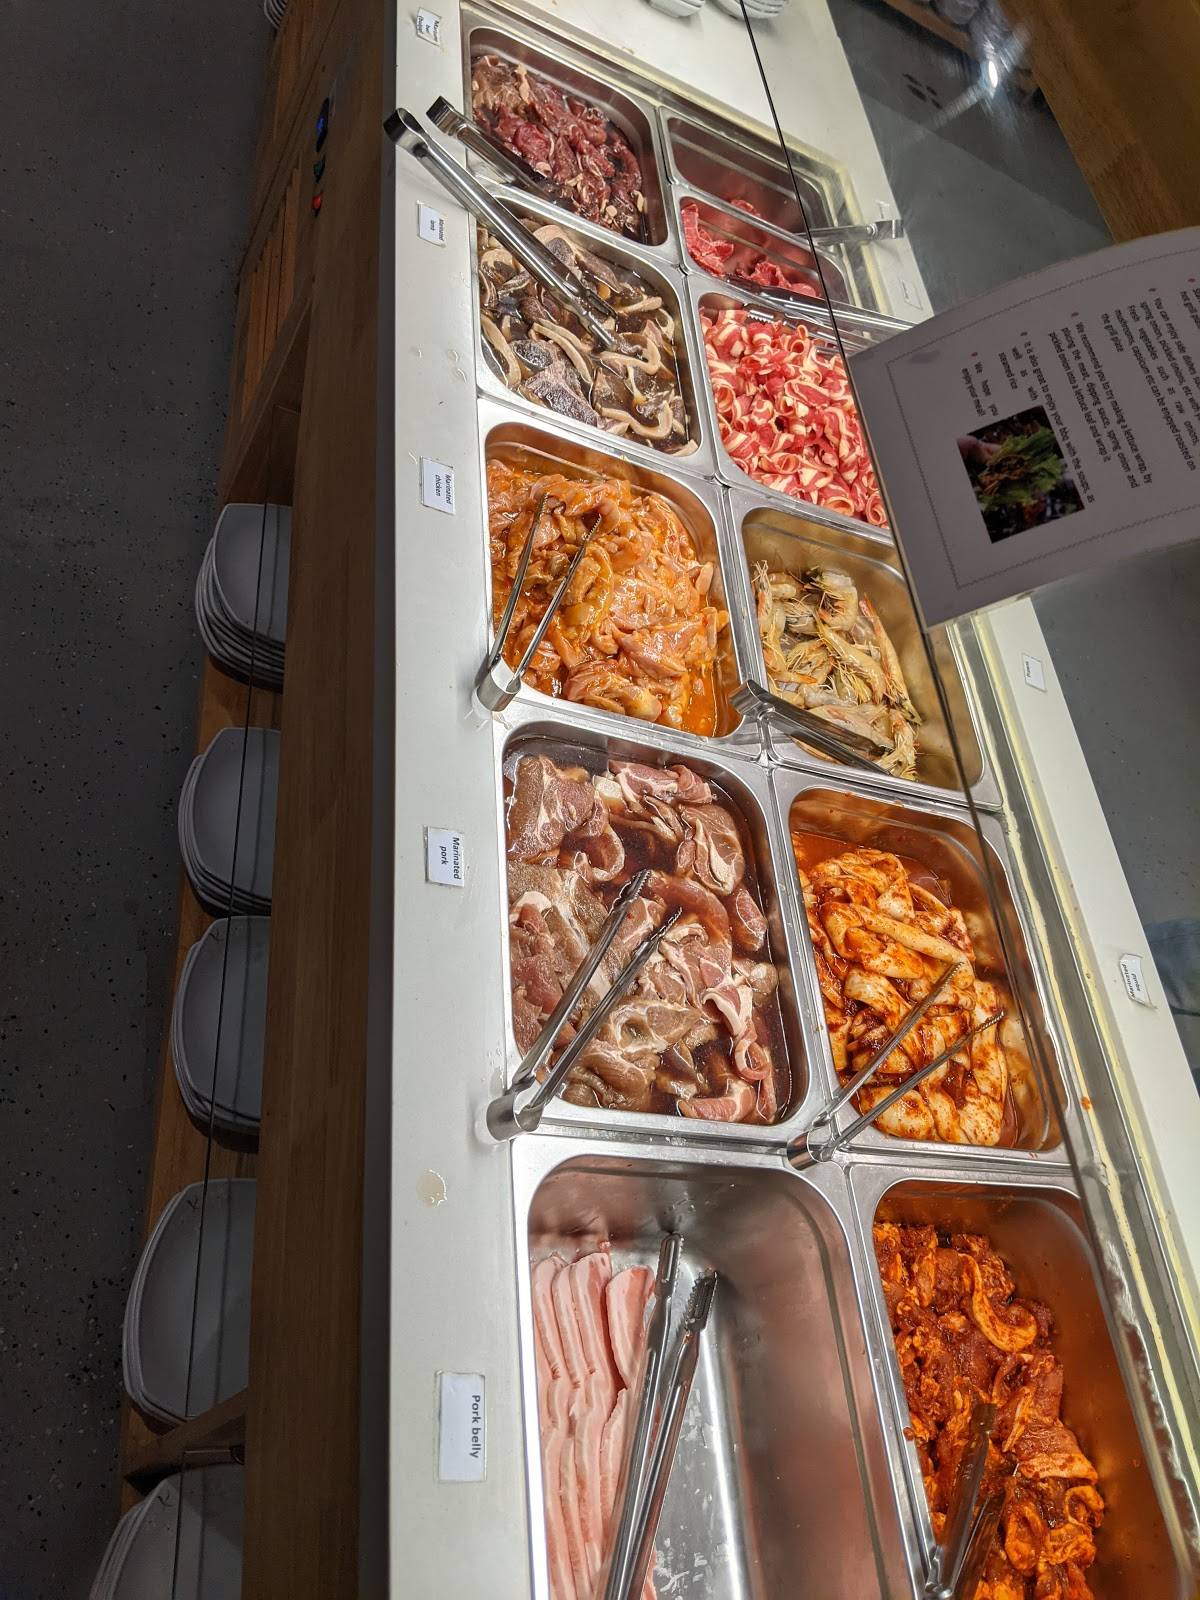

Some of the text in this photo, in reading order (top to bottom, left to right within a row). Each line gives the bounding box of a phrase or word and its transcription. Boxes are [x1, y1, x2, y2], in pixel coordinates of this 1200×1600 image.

[1180, 291, 1190, 302] hot
[1184, 302, 1197, 314] grill
[1075, 322, 1085, 334] We
[1101, 313, 1124, 352] the grill plate
[1154, 297, 1164, 310] You
[1159, 310, 1170, 322] can
[1166, 322, 1179, 340] enjoy
[1175, 340, 1186, 354] side
[1182, 355, 1197, 375] dishes
[1048, 331, 1065, 353] pickled
[1081, 334, 1102, 369] recommend
[1132, 346, 1150, 374] capsicum
[1140, 301, 1154, 321] spring
[1159, 340, 1176, 362] pickled
[1182, 385, 1192, 397] etc
[1188, 396, 1200, 413] with
[1028, 354, 1039, 367] also
[1058, 353, 1071, 371] onion
[962, 368, 972, 385] enjoy
[998, 352, 1018, 390] steamed rice
[1011, 346, 1039, 401] well as with
[1032, 367, 1046, 385] great
[1066, 370, 1077, 385] into
[1094, 369, 1106, 382] you
[1139, 328, 1158, 360] vegetables
[1156, 366, 1169, 381] such
[1167, 387, 1176, 395] as
[1175, 400, 1185, 414] raw
[974, 361, 983, 374] We
[988, 404, 999, 416] you
[1041, 384, 1049, 393] to
[1102, 381, 1110, 390] to
[1145, 374, 1156, 386] etc
[966, 384, 978, 399] your
[1074, 388, 1088, 412] lettuce
[1105, 389, 1115, 400] try
[1150, 385, 1161, 398] can
[1045, 393, 1056, 411] enjoy
[1061, 327, 1076, 349] placing
[1072, 349, 1082, 361] the
[1086, 382, 1101, 406] dipping
[1107, 430, 1122, 452] spring
[1117, 452, 1131, 472] onion
[1127, 474, 1139, 488] and
[1156, 396, 1166, 407] be
[1050, 411, 1064, 426] your
[1084, 411, 1097, 426] leaf
[1110, 400, 1126, 425] making
[1161, 407, 1181, 433] enjoyed
[1059, 427, 1069, 442] bbq
[1089, 423, 1102, 438] and
[1065, 441, 1077, 457] with
[1096, 438, 1108, 456] wrap
[1123, 428, 1139, 453] lettuce
[1174, 433, 1194, 460] roasted
[1072, 457, 1082, 470] the
[1103, 454, 1111, 463] it
[1187, 460, 1196, 471] on
[1144, 474, 1152, 483] by
[1086, 494, 1095, 503] as
[439, 846, 449, 865] pork
[452, 837, 461, 880] Marinated
[1122, 964, 1135, 998] Marinated
[469, 1395, 481, 1458] Pork belly
